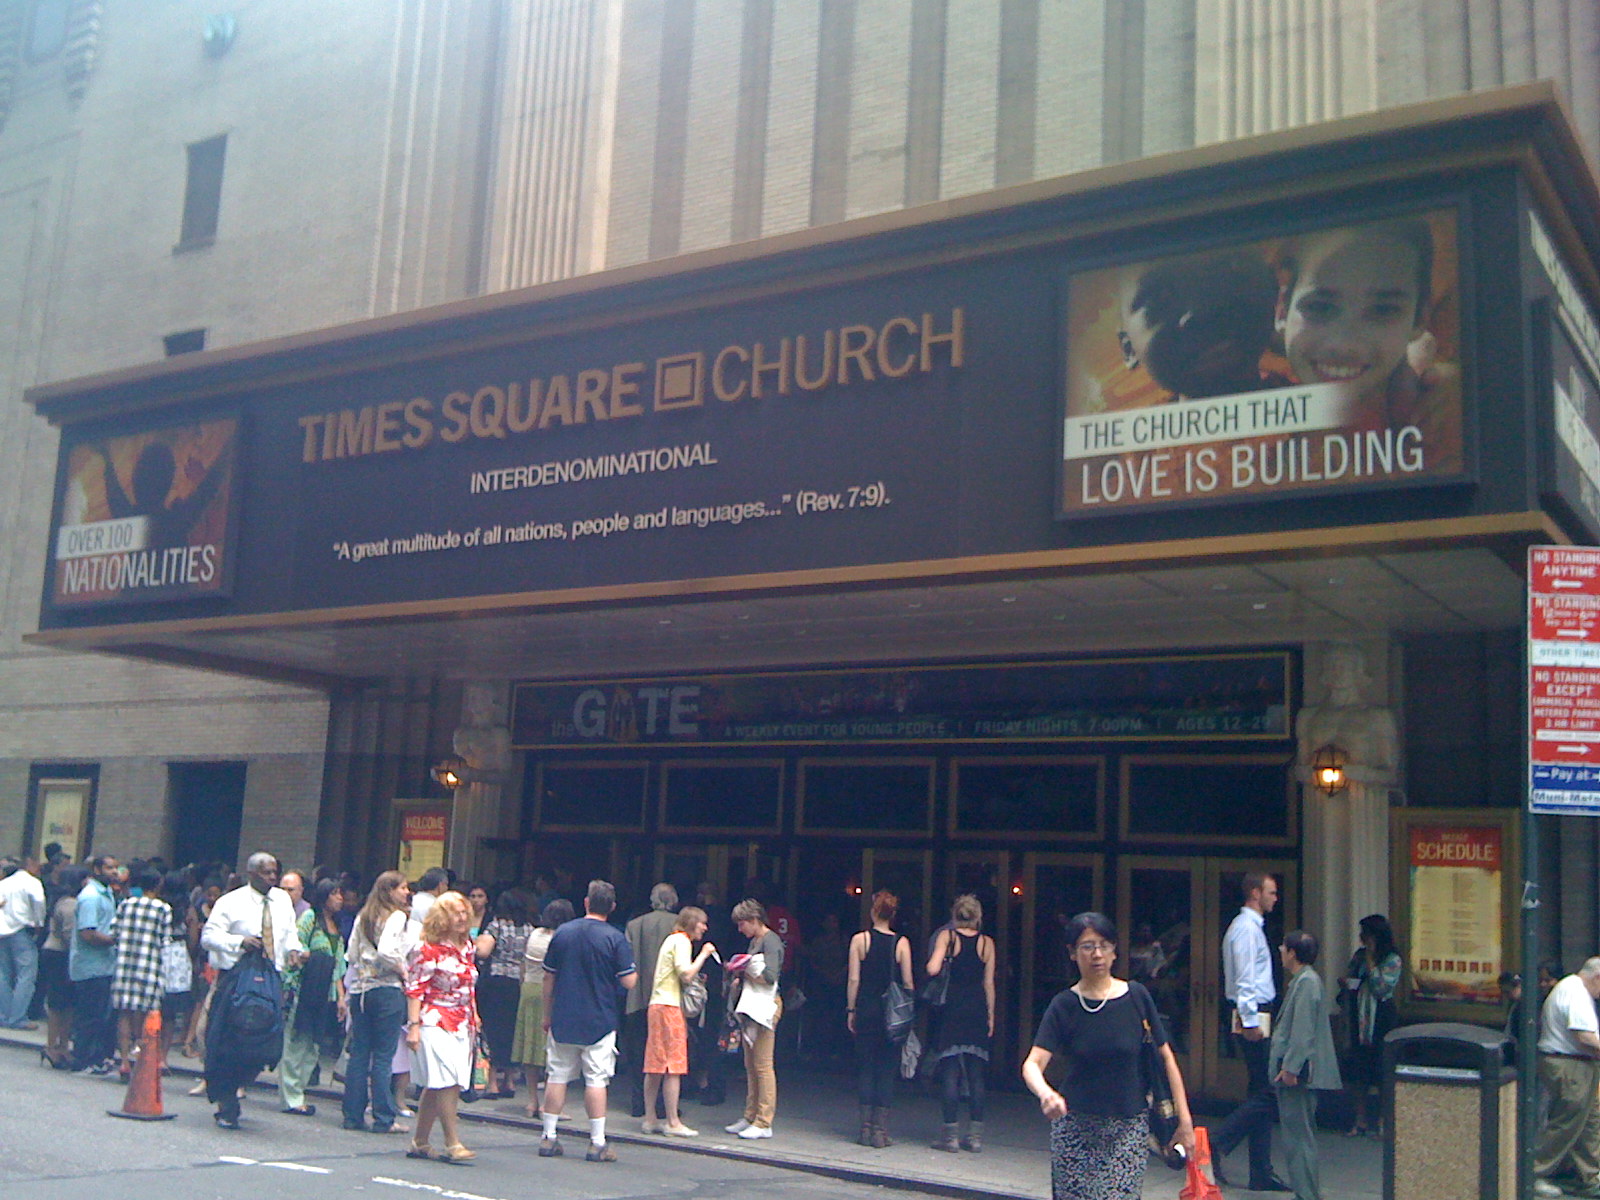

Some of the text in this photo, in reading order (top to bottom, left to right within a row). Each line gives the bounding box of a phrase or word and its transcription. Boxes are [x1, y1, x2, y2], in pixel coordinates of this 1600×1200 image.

[299, 307, 966, 463] TIMES SQUARE CHURCH
[1079, 393, 1312, 451] THE CHURCH THAT
[470, 441, 718, 494] INTERDENOMINATIONAL
[1081, 425, 1425, 504] LOVE IS BUILDING
[352, 537, 389, 563] great
[392, 527, 461, 555] multitude
[463, 527, 481, 547] of
[483, 525, 501, 544] all
[505, 520, 568, 542] nations,
[571, 511, 630, 538] people
[633, 506, 667, 532] and
[796, 489, 844, 516] (Rev.
[848, 480, 891, 509] 7:9).
[68, 522, 133, 555] OVER 100
[1534, 551, 1549, 563] NO
[63, 543, 216, 595] NATIONALITIES
[1542, 565, 1597, 578] ANYTIME
[1535, 671, 1550, 682] NO
[1547, 684, 1593, 698] EXCEPT
[823, 723, 847, 736] FOR
[1551, 767, 1573, 783] Pay
[1416, 841, 1495, 862] SCHEDULE
[778, 918, 788, 934] 3
